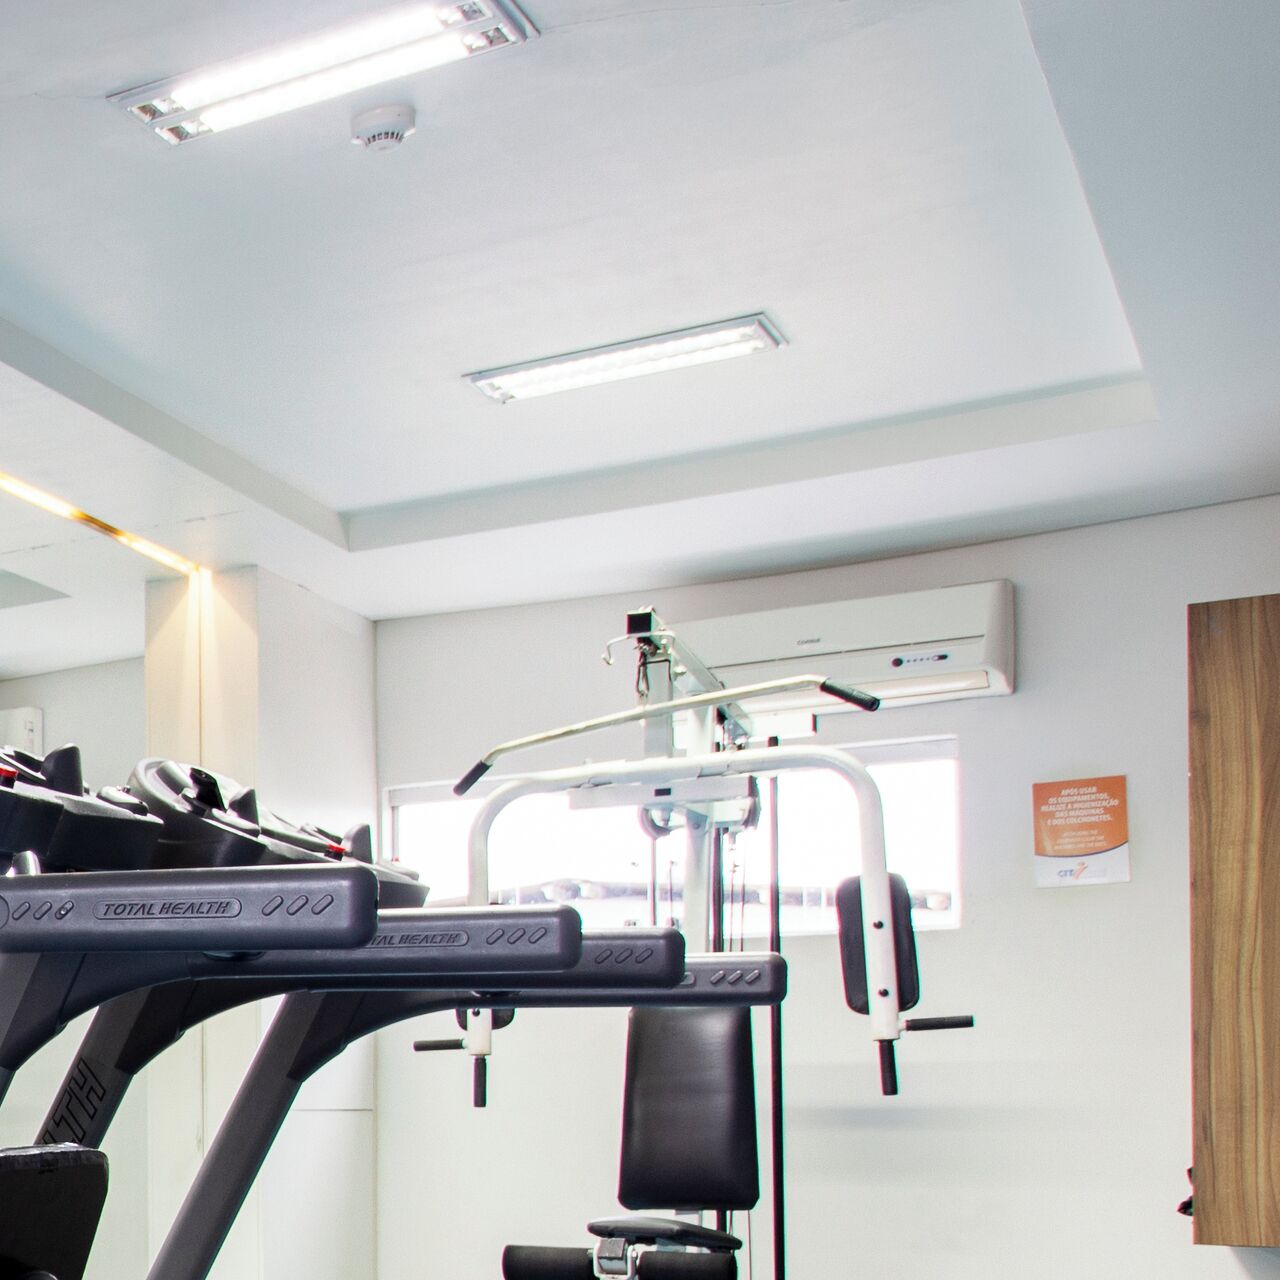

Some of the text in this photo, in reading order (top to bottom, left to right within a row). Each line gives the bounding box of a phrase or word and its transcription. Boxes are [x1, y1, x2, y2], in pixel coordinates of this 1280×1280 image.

[102, 901, 230, 916] TOTAL HEALTH
[398, 932, 460, 945] HEALTH
